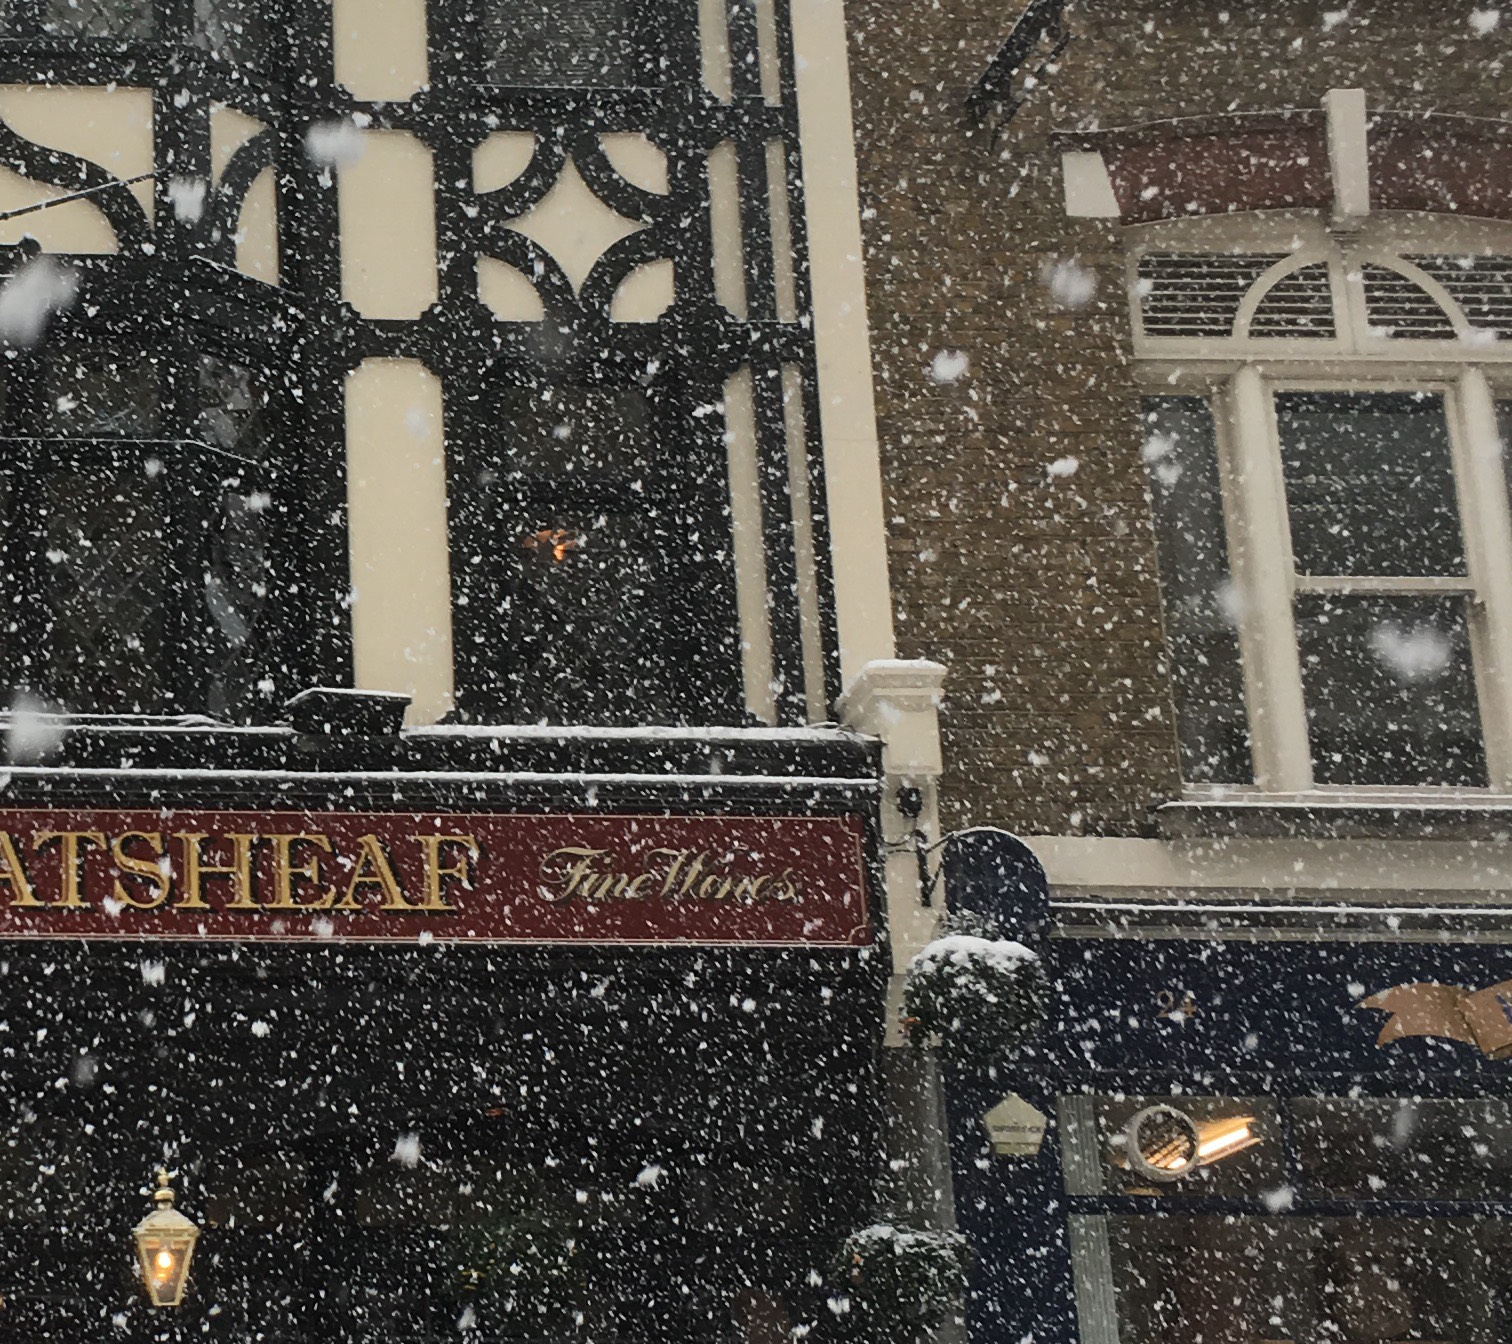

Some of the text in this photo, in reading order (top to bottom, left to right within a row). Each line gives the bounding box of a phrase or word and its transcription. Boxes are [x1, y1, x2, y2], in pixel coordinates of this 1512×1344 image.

[539, 845, 799, 902] Fine Wines
[1156, 988, 1198, 1018] 24
